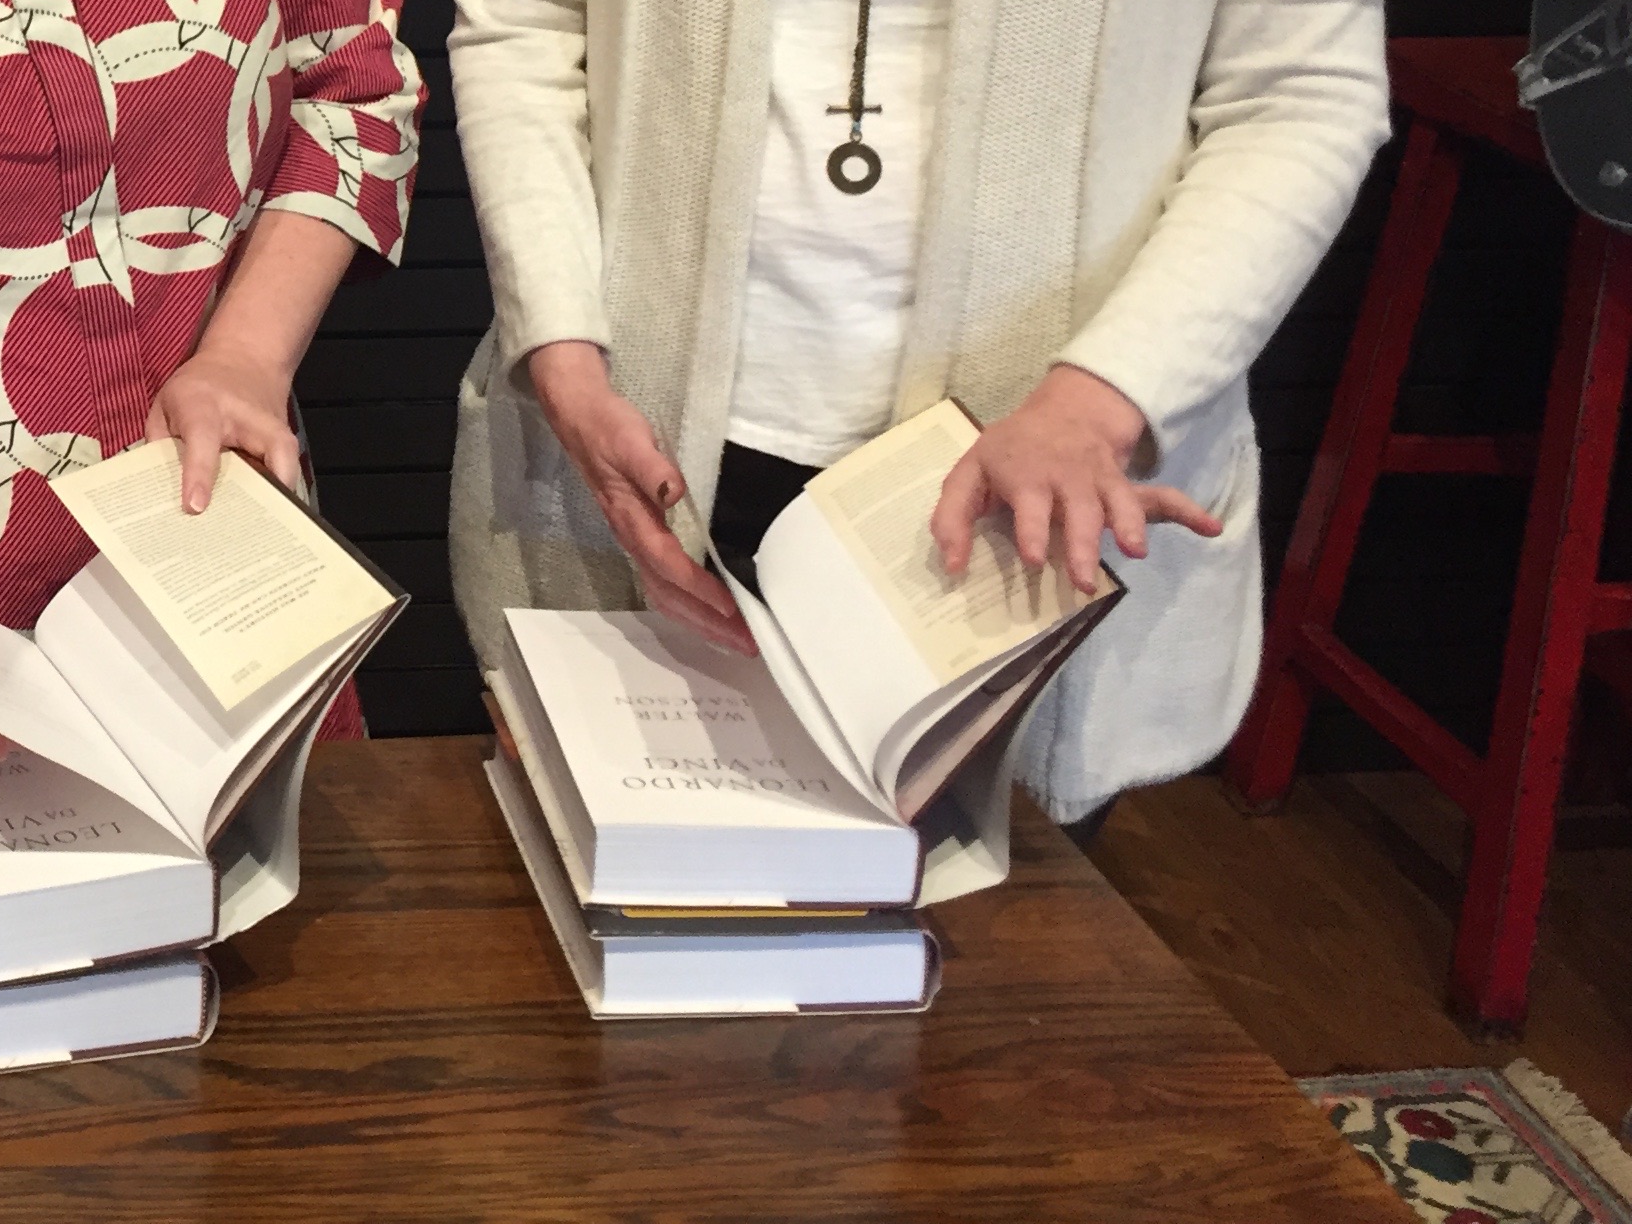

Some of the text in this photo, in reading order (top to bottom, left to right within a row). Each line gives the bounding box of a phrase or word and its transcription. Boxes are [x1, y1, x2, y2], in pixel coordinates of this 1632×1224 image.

[632, 710, 746, 723] WALTER
[642, 756, 750, 773] VINCI
[620, 776, 832, 794] LEONARDO
